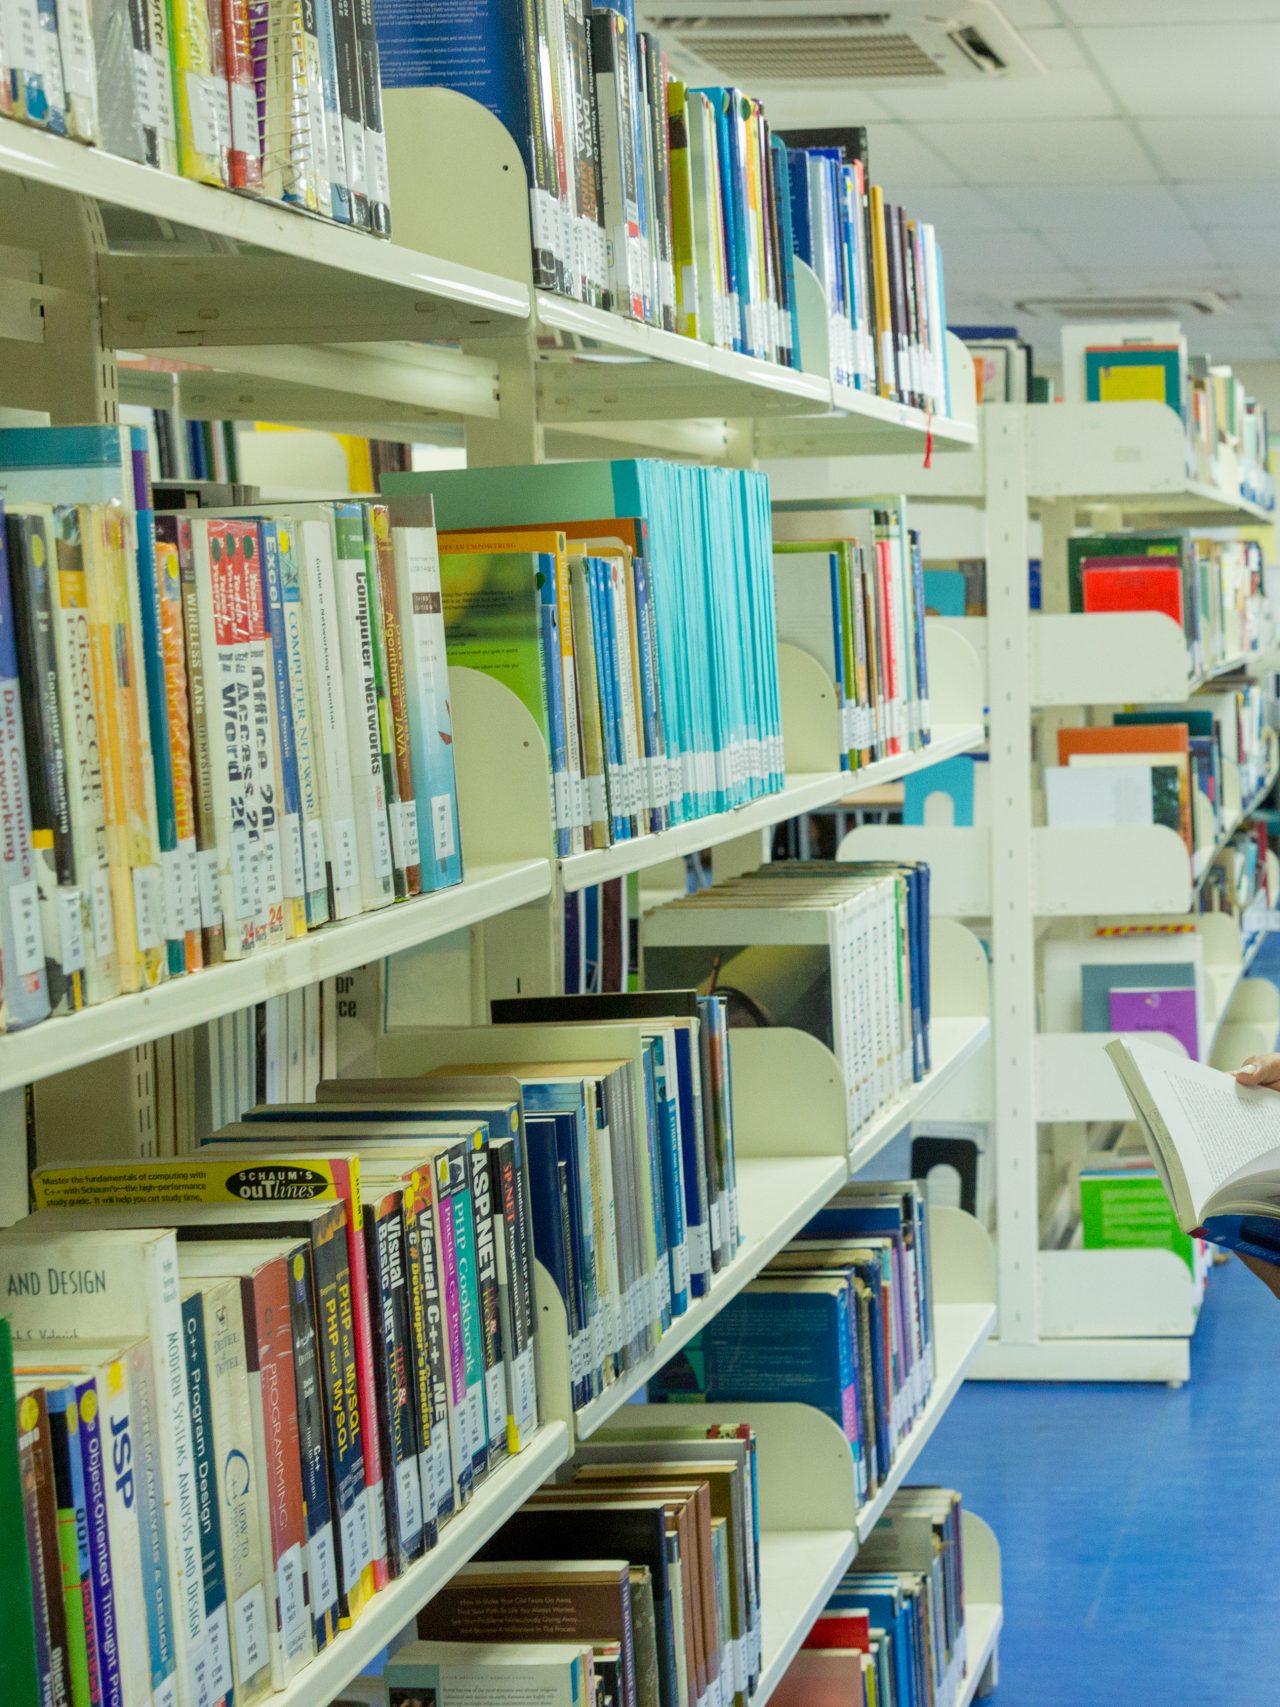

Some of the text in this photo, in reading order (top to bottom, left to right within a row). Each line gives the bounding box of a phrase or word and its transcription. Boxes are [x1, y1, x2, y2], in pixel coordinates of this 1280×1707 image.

[584, 18, 595, 92] Programming
[531, 70, 541, 136] INFORMATION
[575, 92, 584, 151] DATA
[583, 99, 592, 157] DATA
[535, 139, 545, 185] SECURITY
[264, 535, 281, 609] Excel
[186, 592, 201, 668] WIRELESS
[287, 610, 306, 720] COMPUTER
[318, 608, 331, 671] Networking
[351, 571, 382, 774] Computer Networks
[3, 689, 15, 740] Data
[74, 614, 103, 802] Cisco CCIE
[192, 675, 204, 714] LANs
[249, 665, 272, 770] Office
[276, 680, 287, 712] Busy
[382, 611, 407, 756] Algorithms JAVA
[47, 671, 68, 834] Computer Networking
[220, 683, 241, 781] Word
[234, 681, 258, 796] Access
[279, 715, 291, 758] People
[268, 905, 283, 926] 24
[148, 1172, 189, 1182] computing
[239, 1171, 313, 1181] SCHAUM'S
[470, 1151, 497, 1281] ASP.NET
[386, 1215, 404, 1290] Visual
[443, 1206, 456, 1274] Practical
[508, 1226, 521, 1315] Programmer's
[514, 1171, 526, 1236] Introduction
[520, 1256, 530, 1305] ASP.NET
[8, 1272, 41, 1297] AND
[378, 1223, 395, 1344] Basic .NET
[407, 1263, 426, 1366] Developer's
[416, 1209, 444, 1364] Visual C++
[453, 1201, 476, 1374] PHP Cookbook
[326, 1298, 339, 1346] PHP
[333, 1378, 348, 1462] MySQL
[339, 1283, 351, 1331] PHP
[346, 1362, 360, 1445] MySQL
[110, 1415, 135, 1509] JSP
[187, 1317, 212, 1534] C++ Program Design
[312, 1444, 323, 1471] C++
[88, 1438, 117, 1671] Object-Oriented Thought
[147, 1468, 160, 1563] ANALYSIS
[155, 1587, 173, 1663] DESIGN
[621, 1610, 634, 1685] MILLIONAIRE
